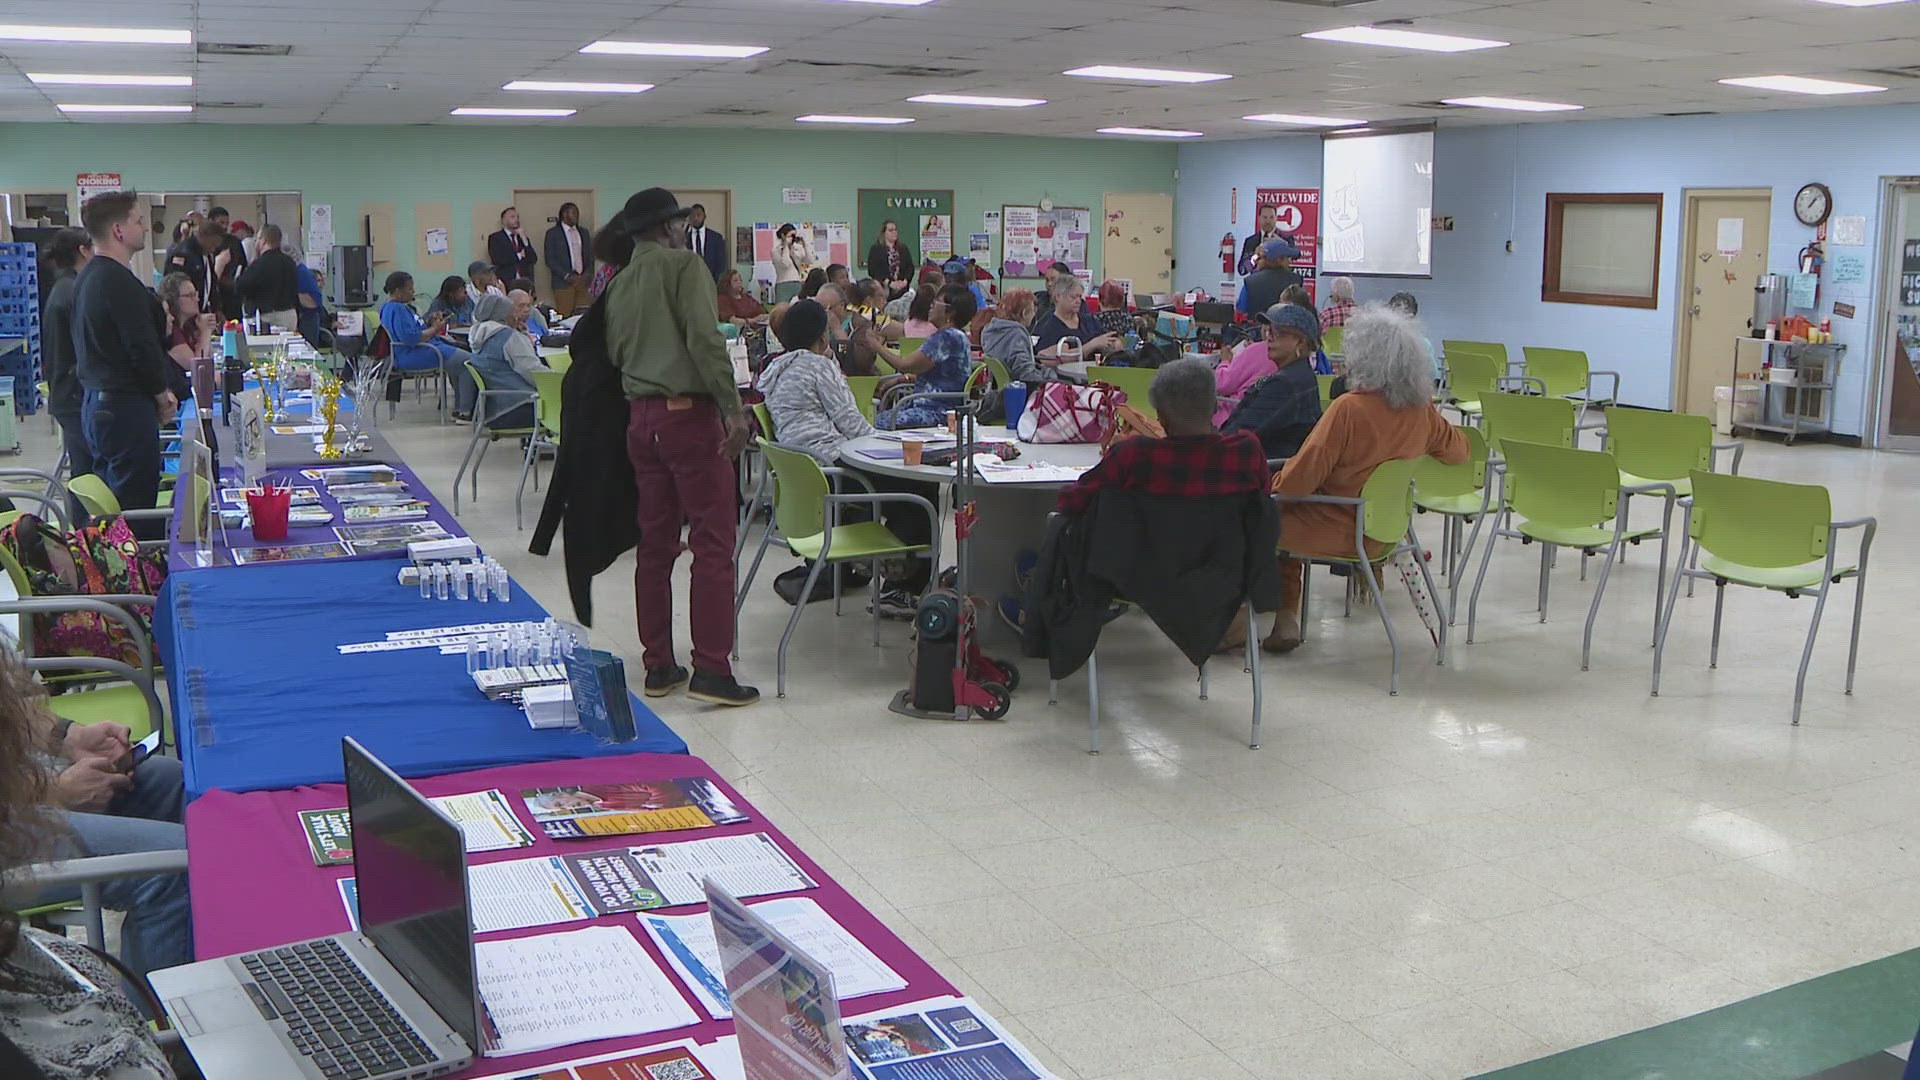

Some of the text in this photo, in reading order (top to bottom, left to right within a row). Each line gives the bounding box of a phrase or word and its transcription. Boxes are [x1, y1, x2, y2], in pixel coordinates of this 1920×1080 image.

[78, 178, 119, 186] CHOKING
[887, 198, 938, 208] EVENTS
[1257, 192, 1318, 204] STATEWIDE
[325, 814, 348, 837] ABOUT
[577, 859, 602, 881] KNOW
[607, 856, 641, 892] NUMBERS?
[592, 857, 633, 904] YOUR HEALTH
[603, 896, 620, 908] DO
